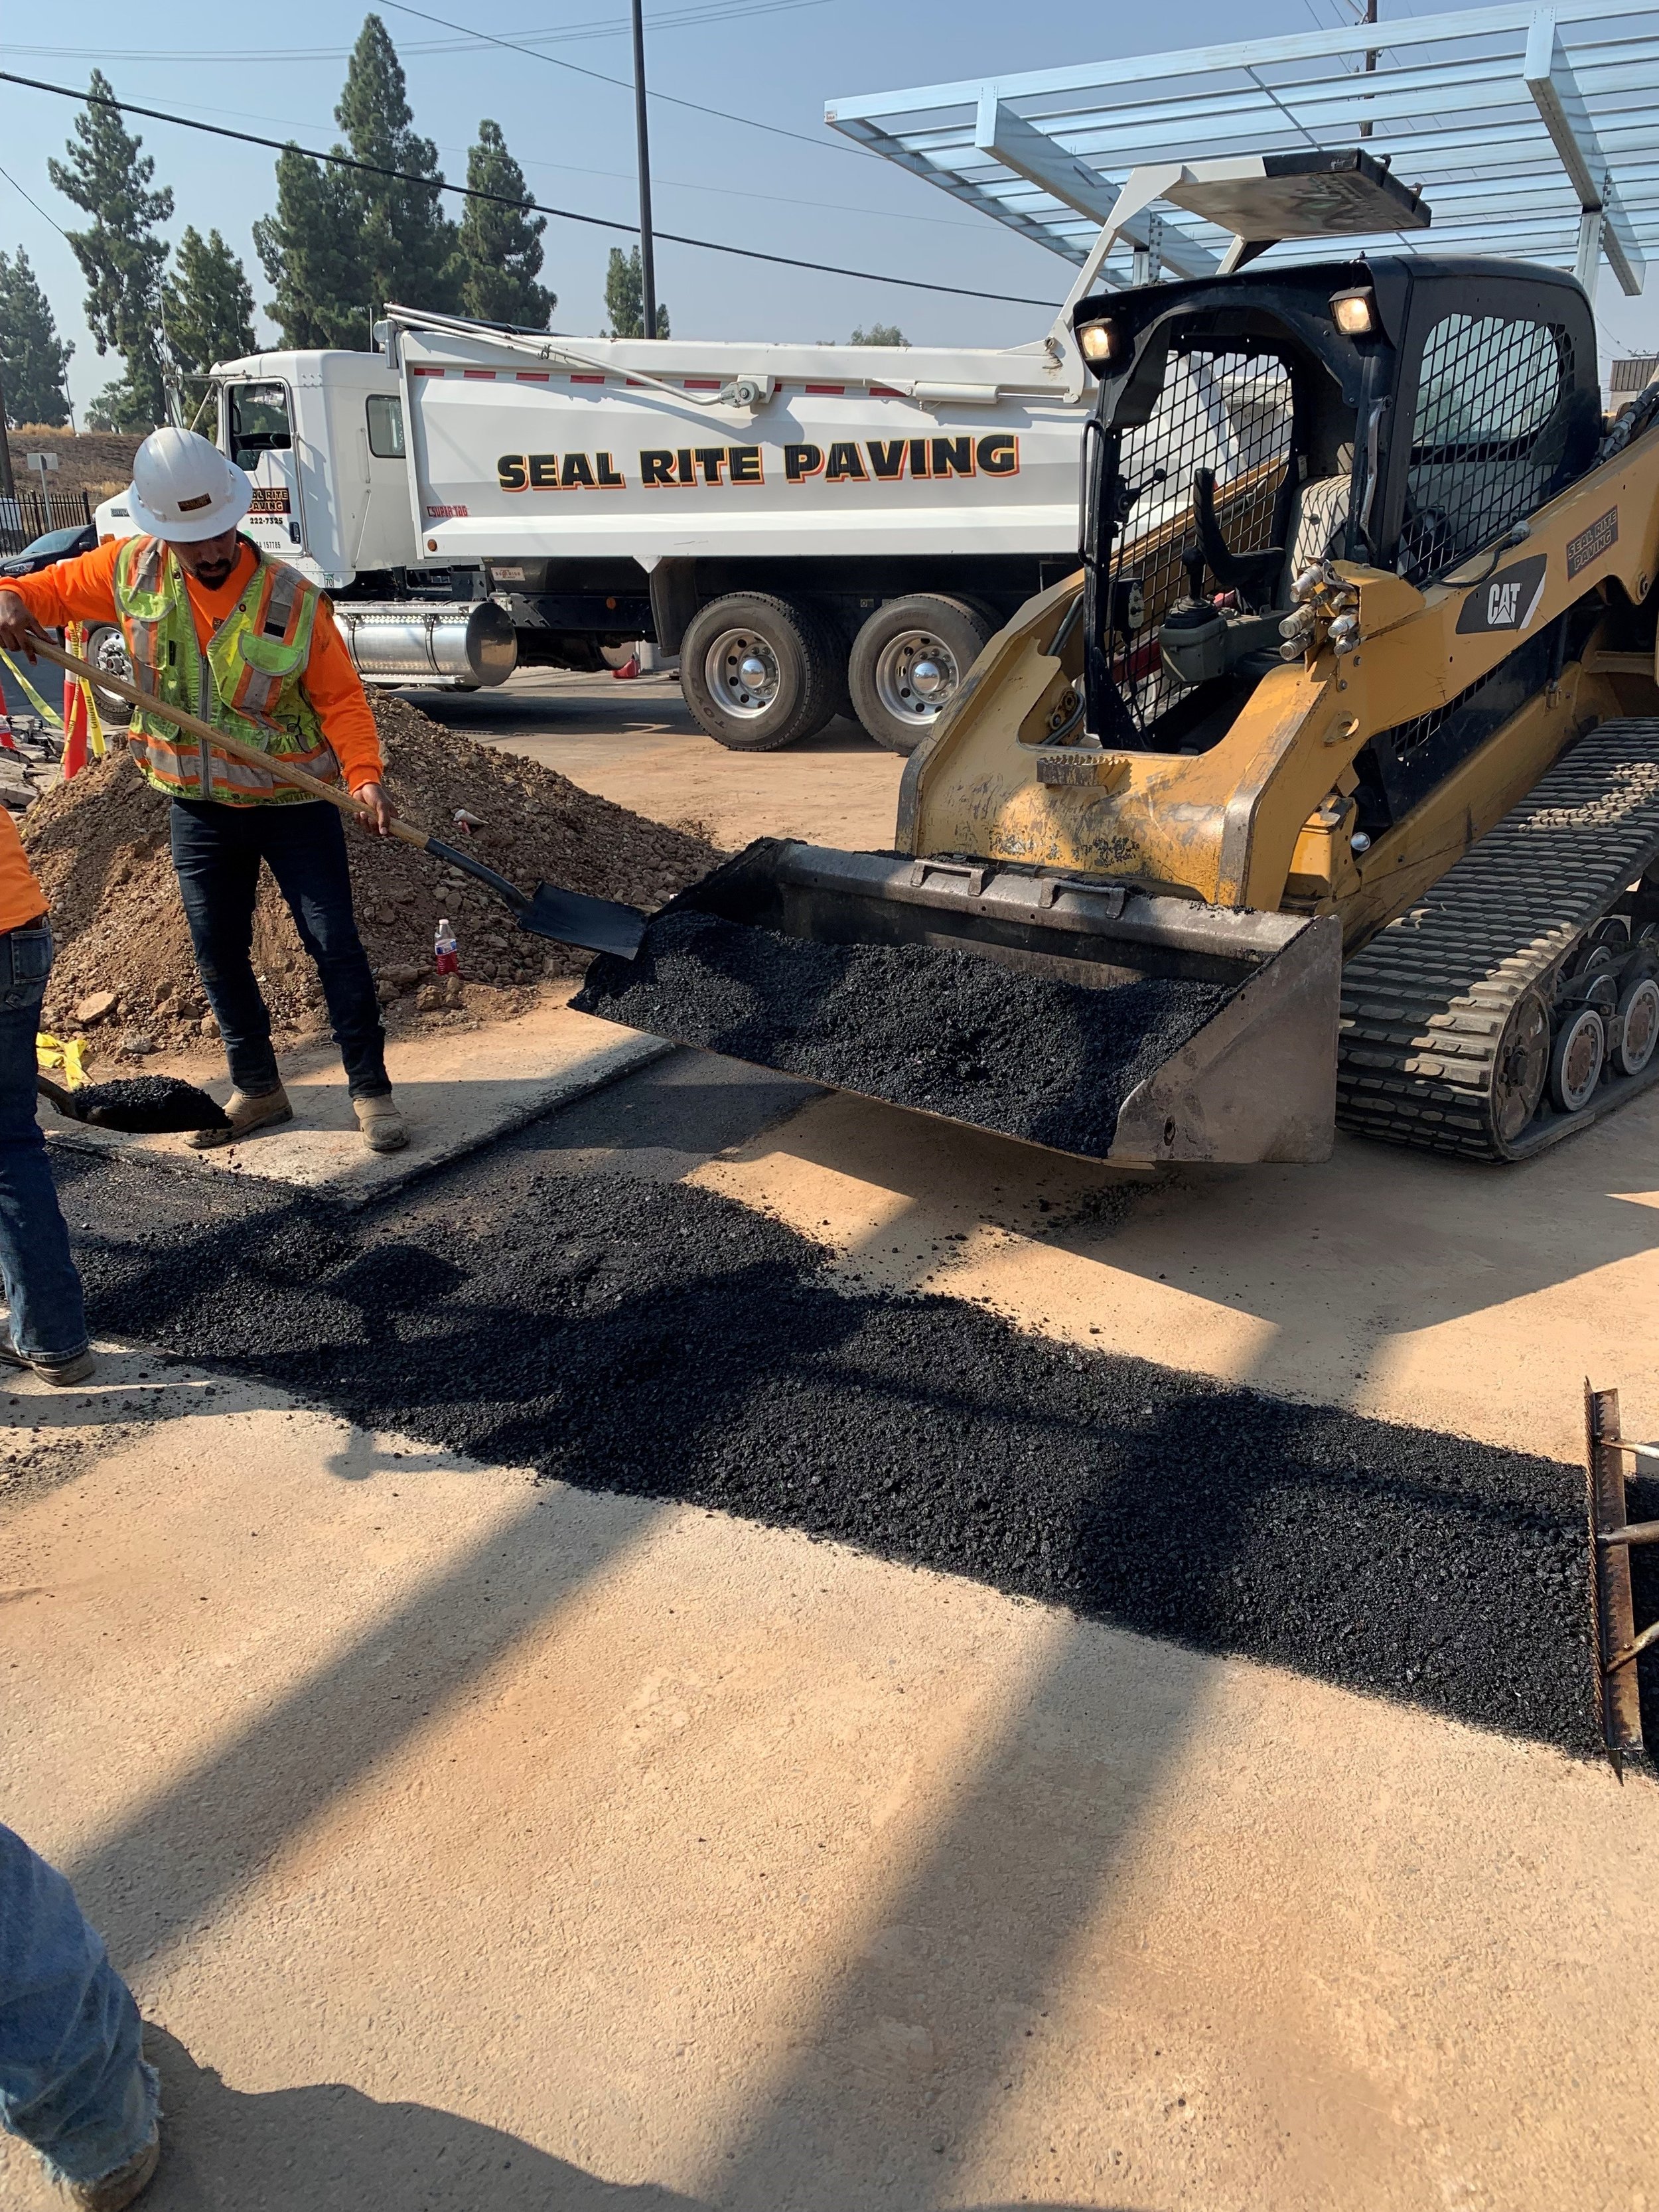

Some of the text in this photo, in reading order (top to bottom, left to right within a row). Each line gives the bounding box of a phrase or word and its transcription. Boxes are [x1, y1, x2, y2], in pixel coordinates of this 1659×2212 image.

[497, 433, 1020, 492] SEAL RITE PAVING
[252, 490, 288, 500] AL RITE
[1567, 510, 1617, 559] SEAL RITE
[1574, 530, 1612, 571] PAVING
[325, 578, 333, 587] 70
[1487, 583, 1521, 625] CAT
